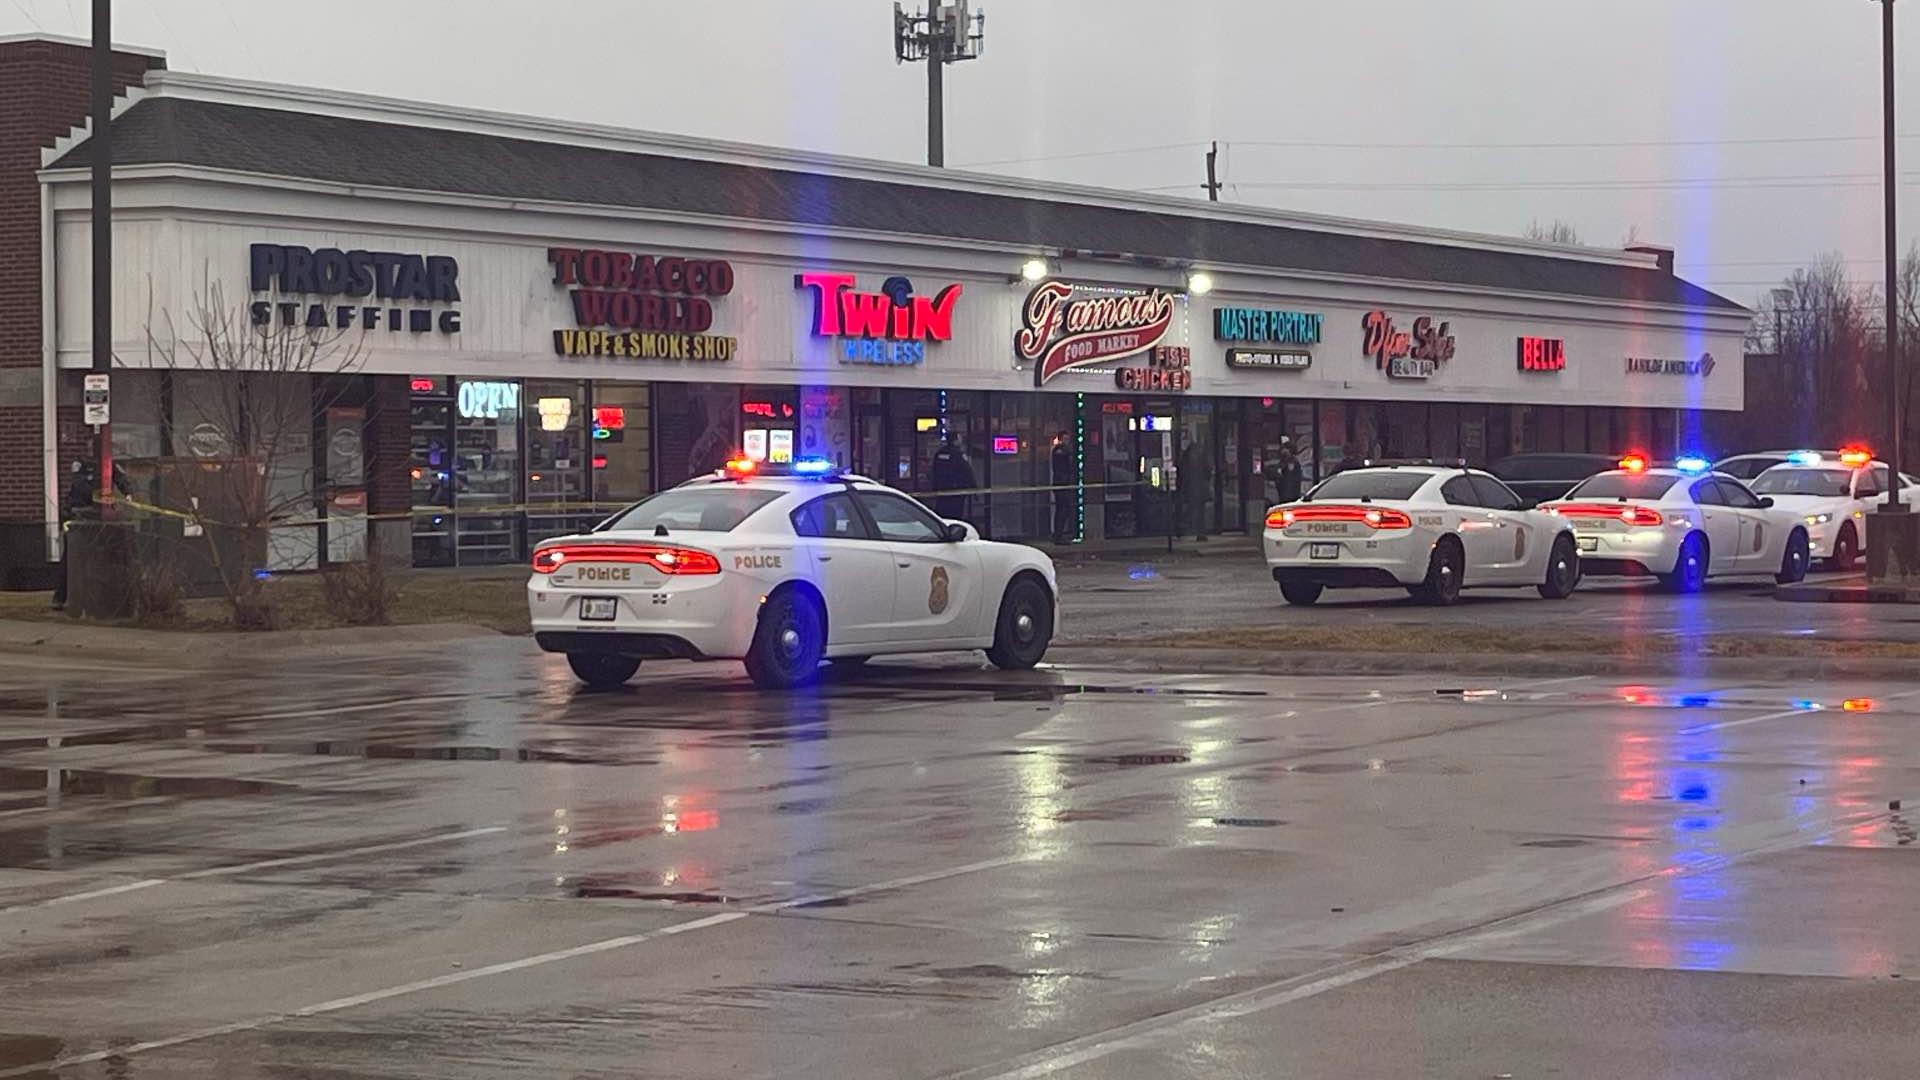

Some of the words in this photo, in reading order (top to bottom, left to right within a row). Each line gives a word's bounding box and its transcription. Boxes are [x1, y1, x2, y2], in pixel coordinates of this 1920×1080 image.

[250, 244, 461, 301] PROSTAR
[548, 248, 734, 296] TOBACCO
[251, 301, 461, 333] STAFFING
[571, 290, 713, 332] WORLD
[1016, 280, 1172, 359] Famous
[1214, 308, 1268, 340] MASTER
[1271, 310, 1324, 343] PORTRAIT
[555, 330, 610, 356] VAPE
[613, 336, 626, 356] &
[629, 333, 690, 359] SMOKE
[693, 337, 737, 361] SHOP
[842, 340, 924, 365] WIRELESS
[1065, 341, 1093, 363] FOOD
[1098, 334, 1140, 353] MARKET
[1150, 345, 1190, 368] FISH
[1518, 336, 1565, 370] BELLA
[1117, 367, 1191, 391] CHICKEN
[458, 382, 519, 418] OPEN
[1307, 523, 1348, 533] POLICE
[577, 567, 631, 581] POLICE
[735, 556, 781, 569] POLICE
